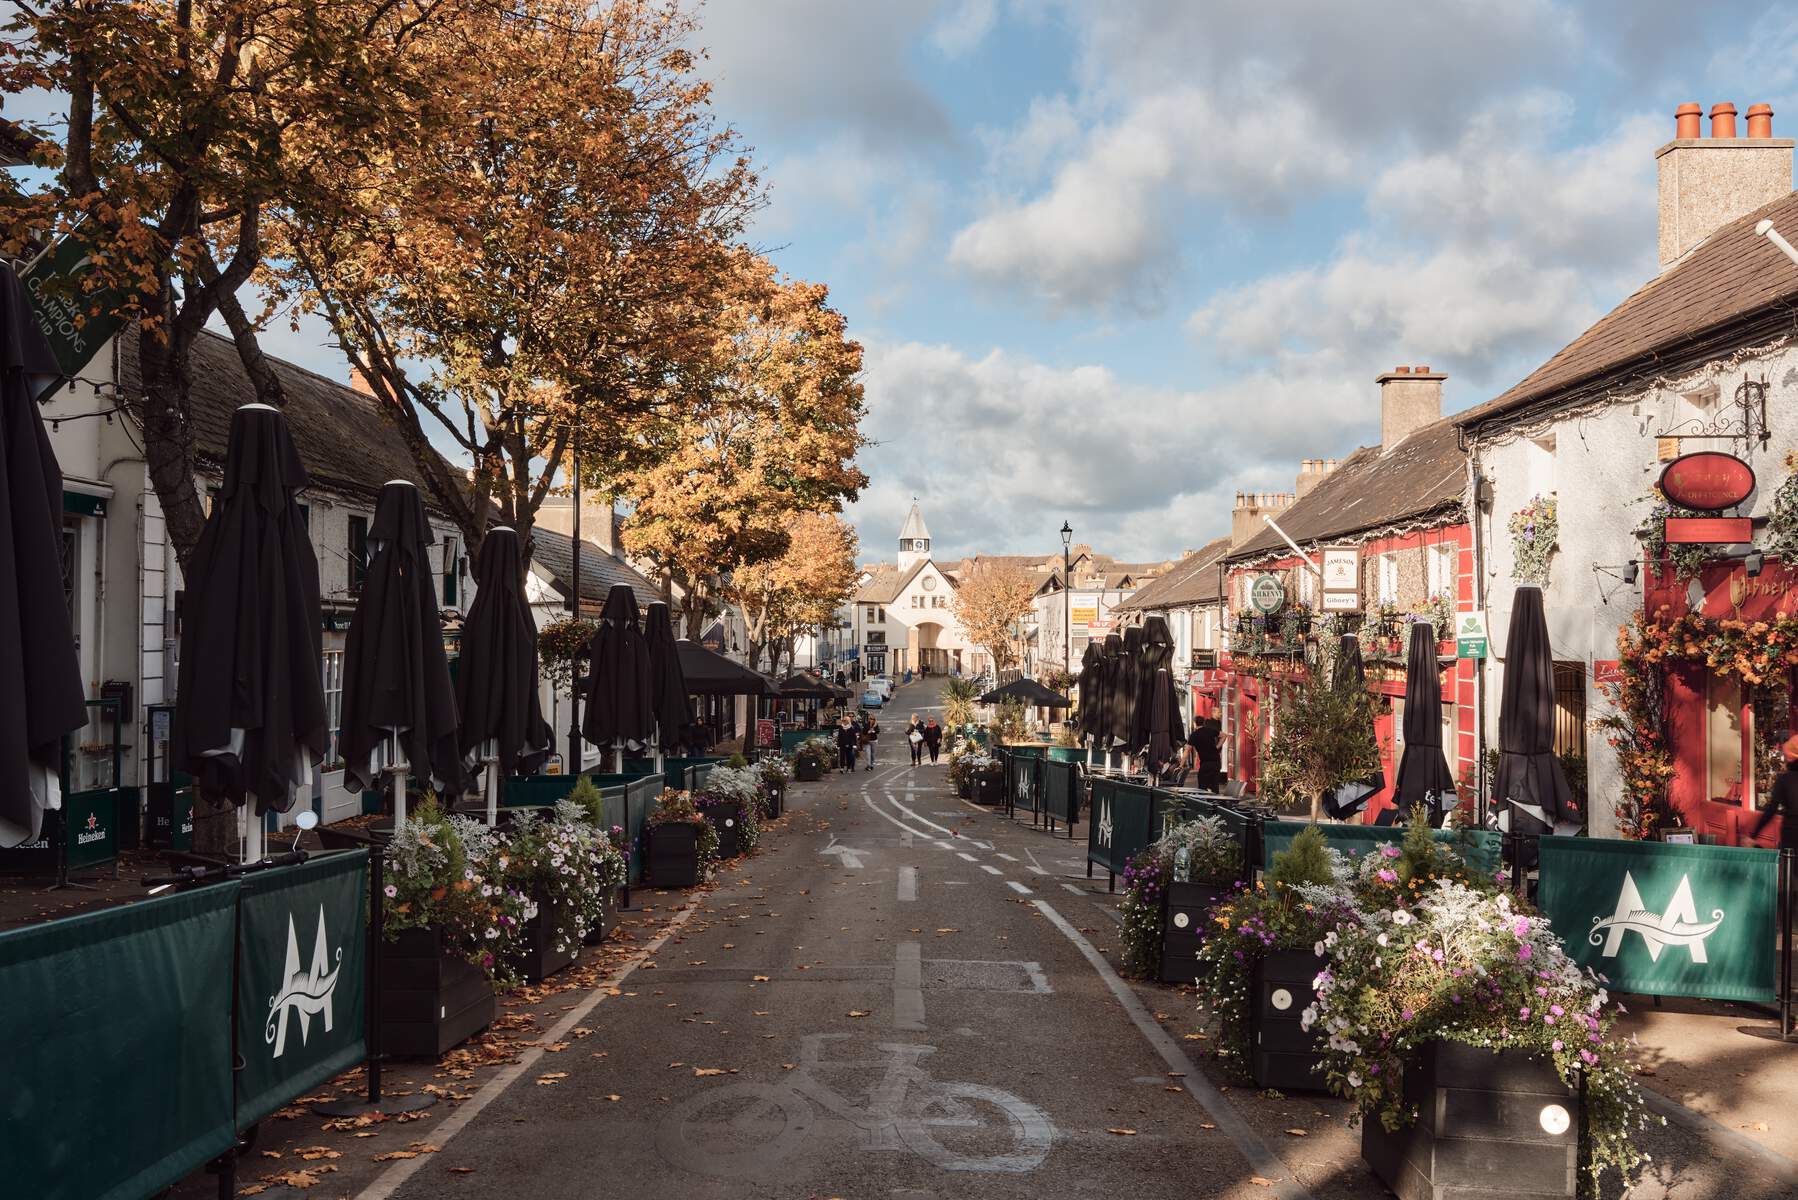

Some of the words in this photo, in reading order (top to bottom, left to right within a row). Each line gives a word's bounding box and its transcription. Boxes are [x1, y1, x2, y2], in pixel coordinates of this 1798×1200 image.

[28, 277, 87, 353] CAMPIONS
[1327, 558, 1354, 566] JAMESON
[1252, 590, 1282, 598] KILKENNY
[78, 830, 106, 845] Heineken
